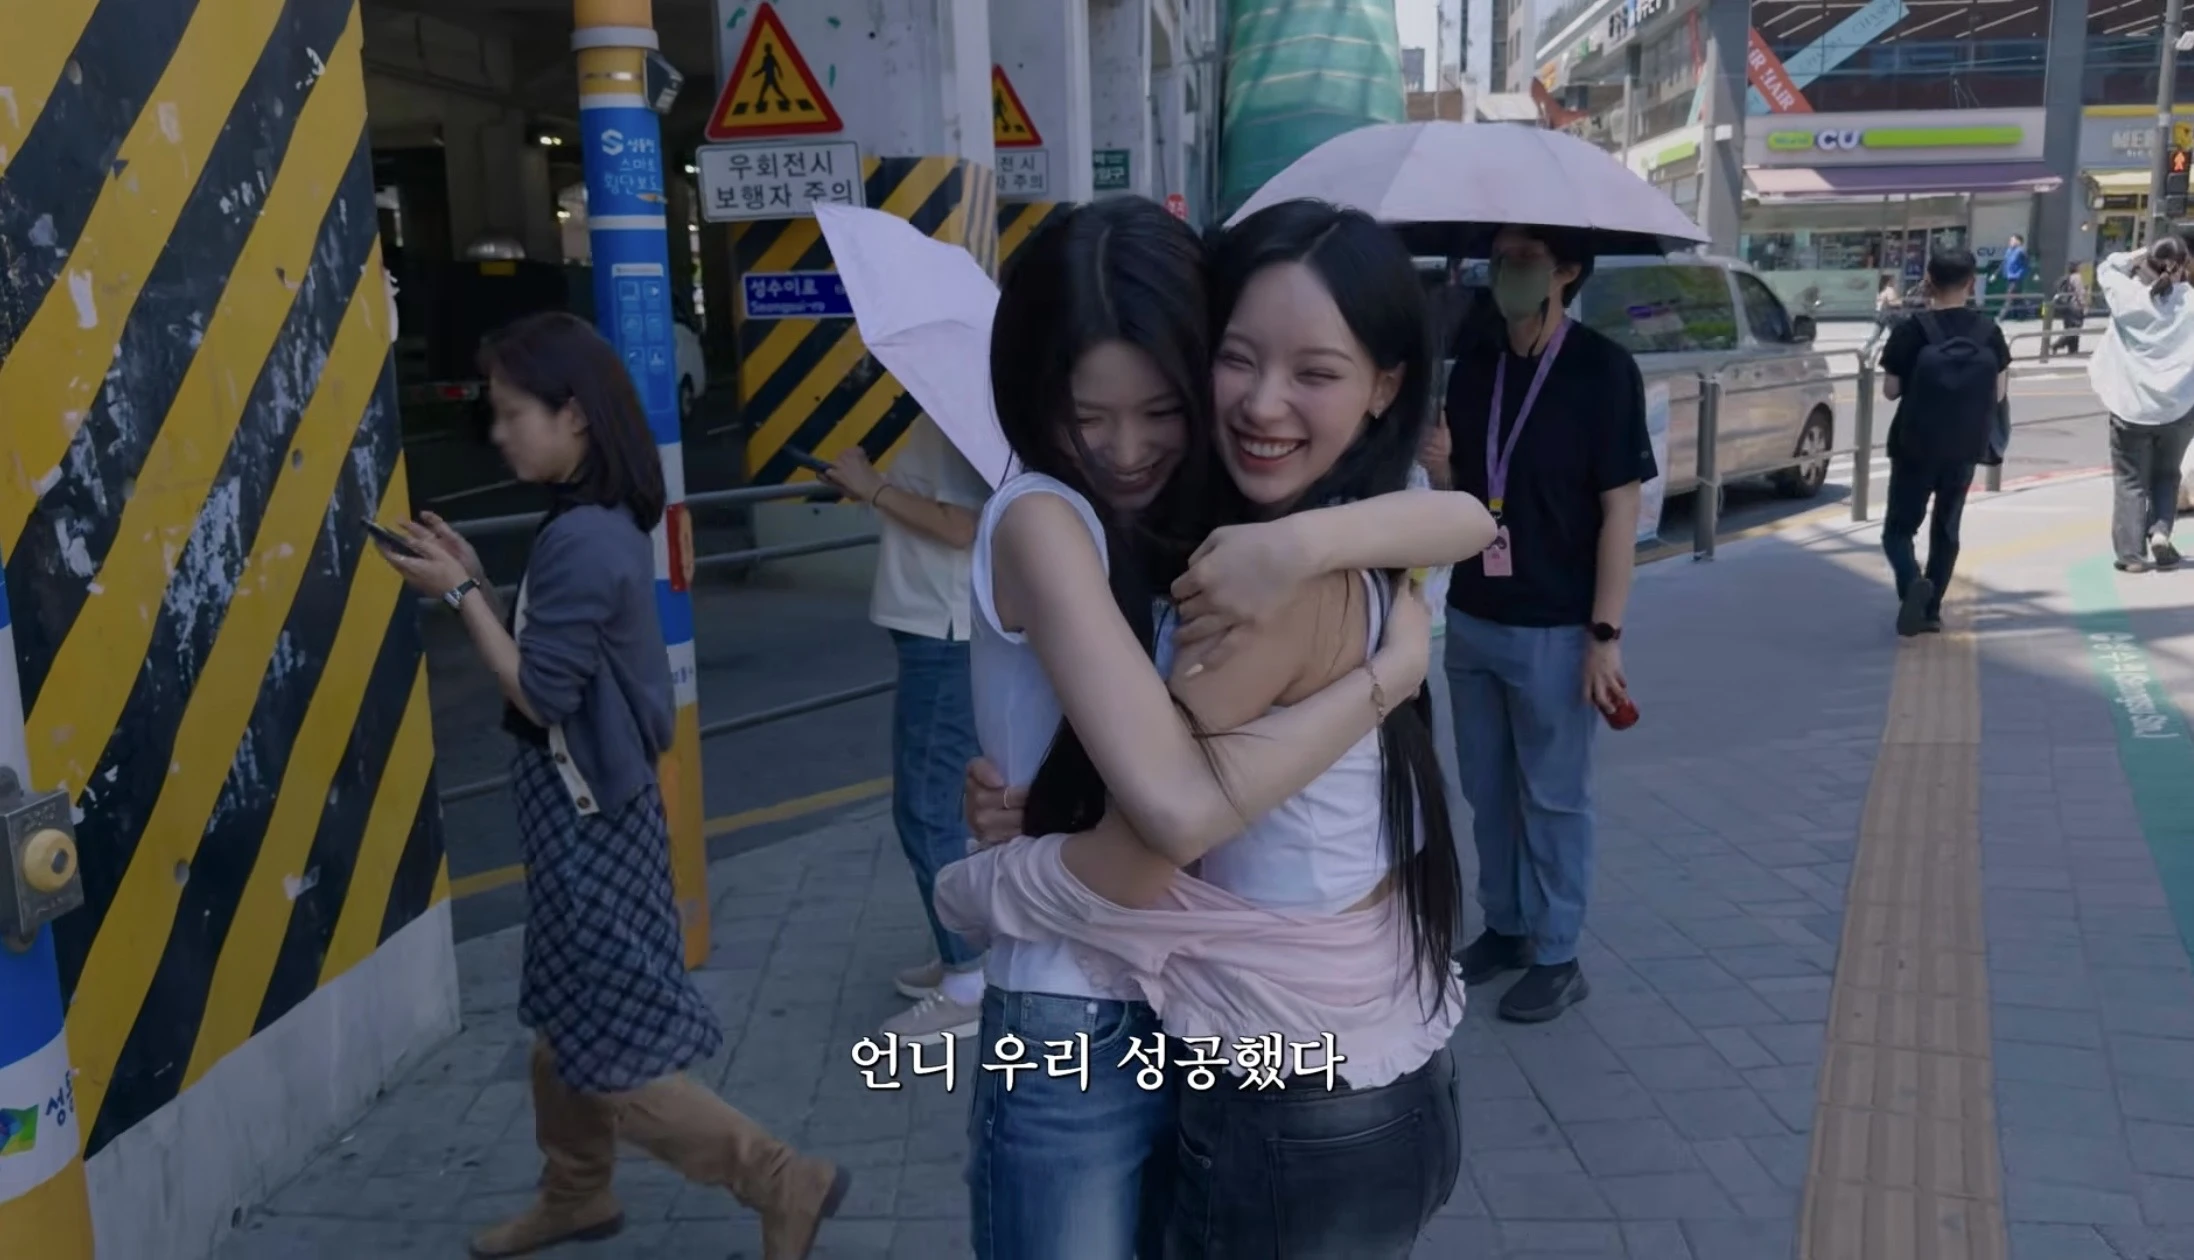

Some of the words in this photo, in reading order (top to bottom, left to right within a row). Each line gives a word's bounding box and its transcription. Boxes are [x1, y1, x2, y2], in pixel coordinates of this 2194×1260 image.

[1817, 129, 1860, 151] CU
[728, 150, 833, 180] 우회전시
[715, 182, 791, 211] 보행자
[803, 179, 853, 205] 주의
[750, 278, 820, 299] 성수이로
